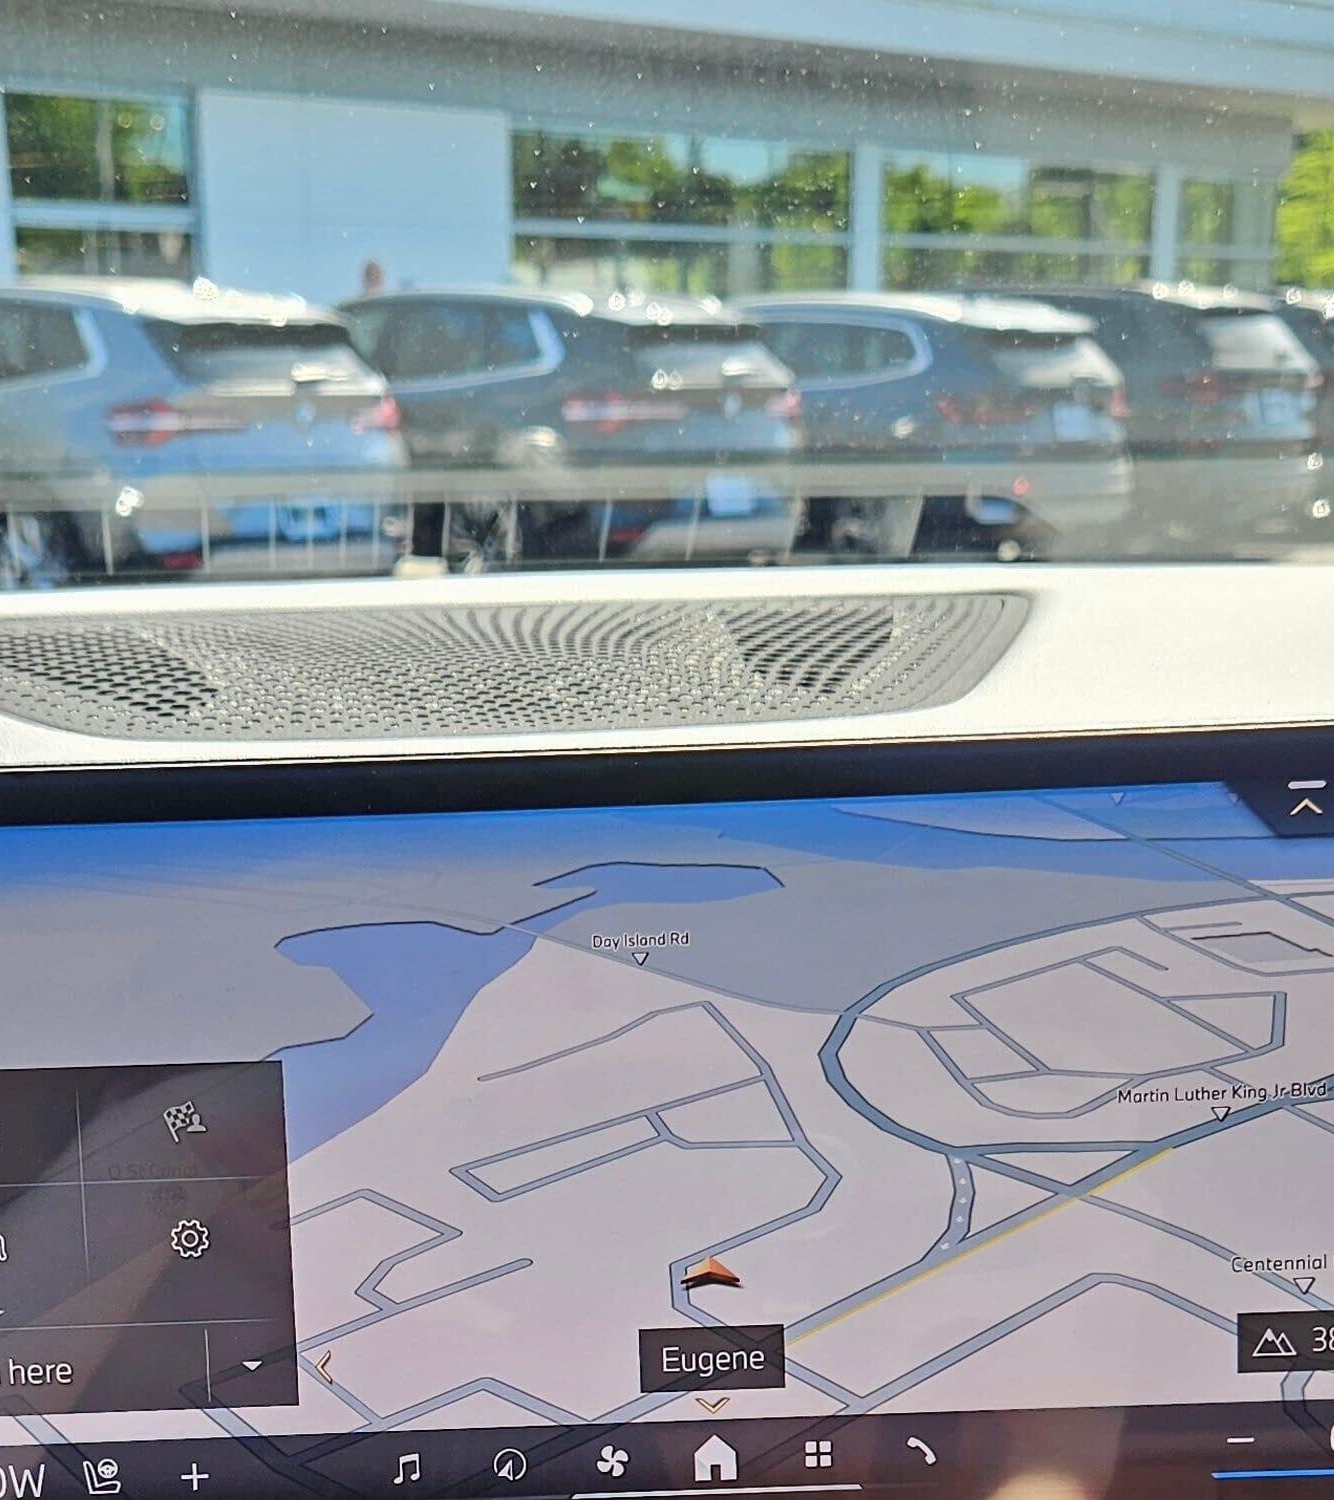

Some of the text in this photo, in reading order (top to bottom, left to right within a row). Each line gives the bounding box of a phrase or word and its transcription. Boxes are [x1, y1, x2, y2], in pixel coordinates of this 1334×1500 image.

[593, 932, 689, 950] Day Island Rd
[1119, 1082, 1327, 1103] Martin Luther King Jr Blvd
[1231, 1252, 1327, 1274] Centennial
[8, 1358, 72, 1387] here
[662, 1346, 765, 1378] Eugene
